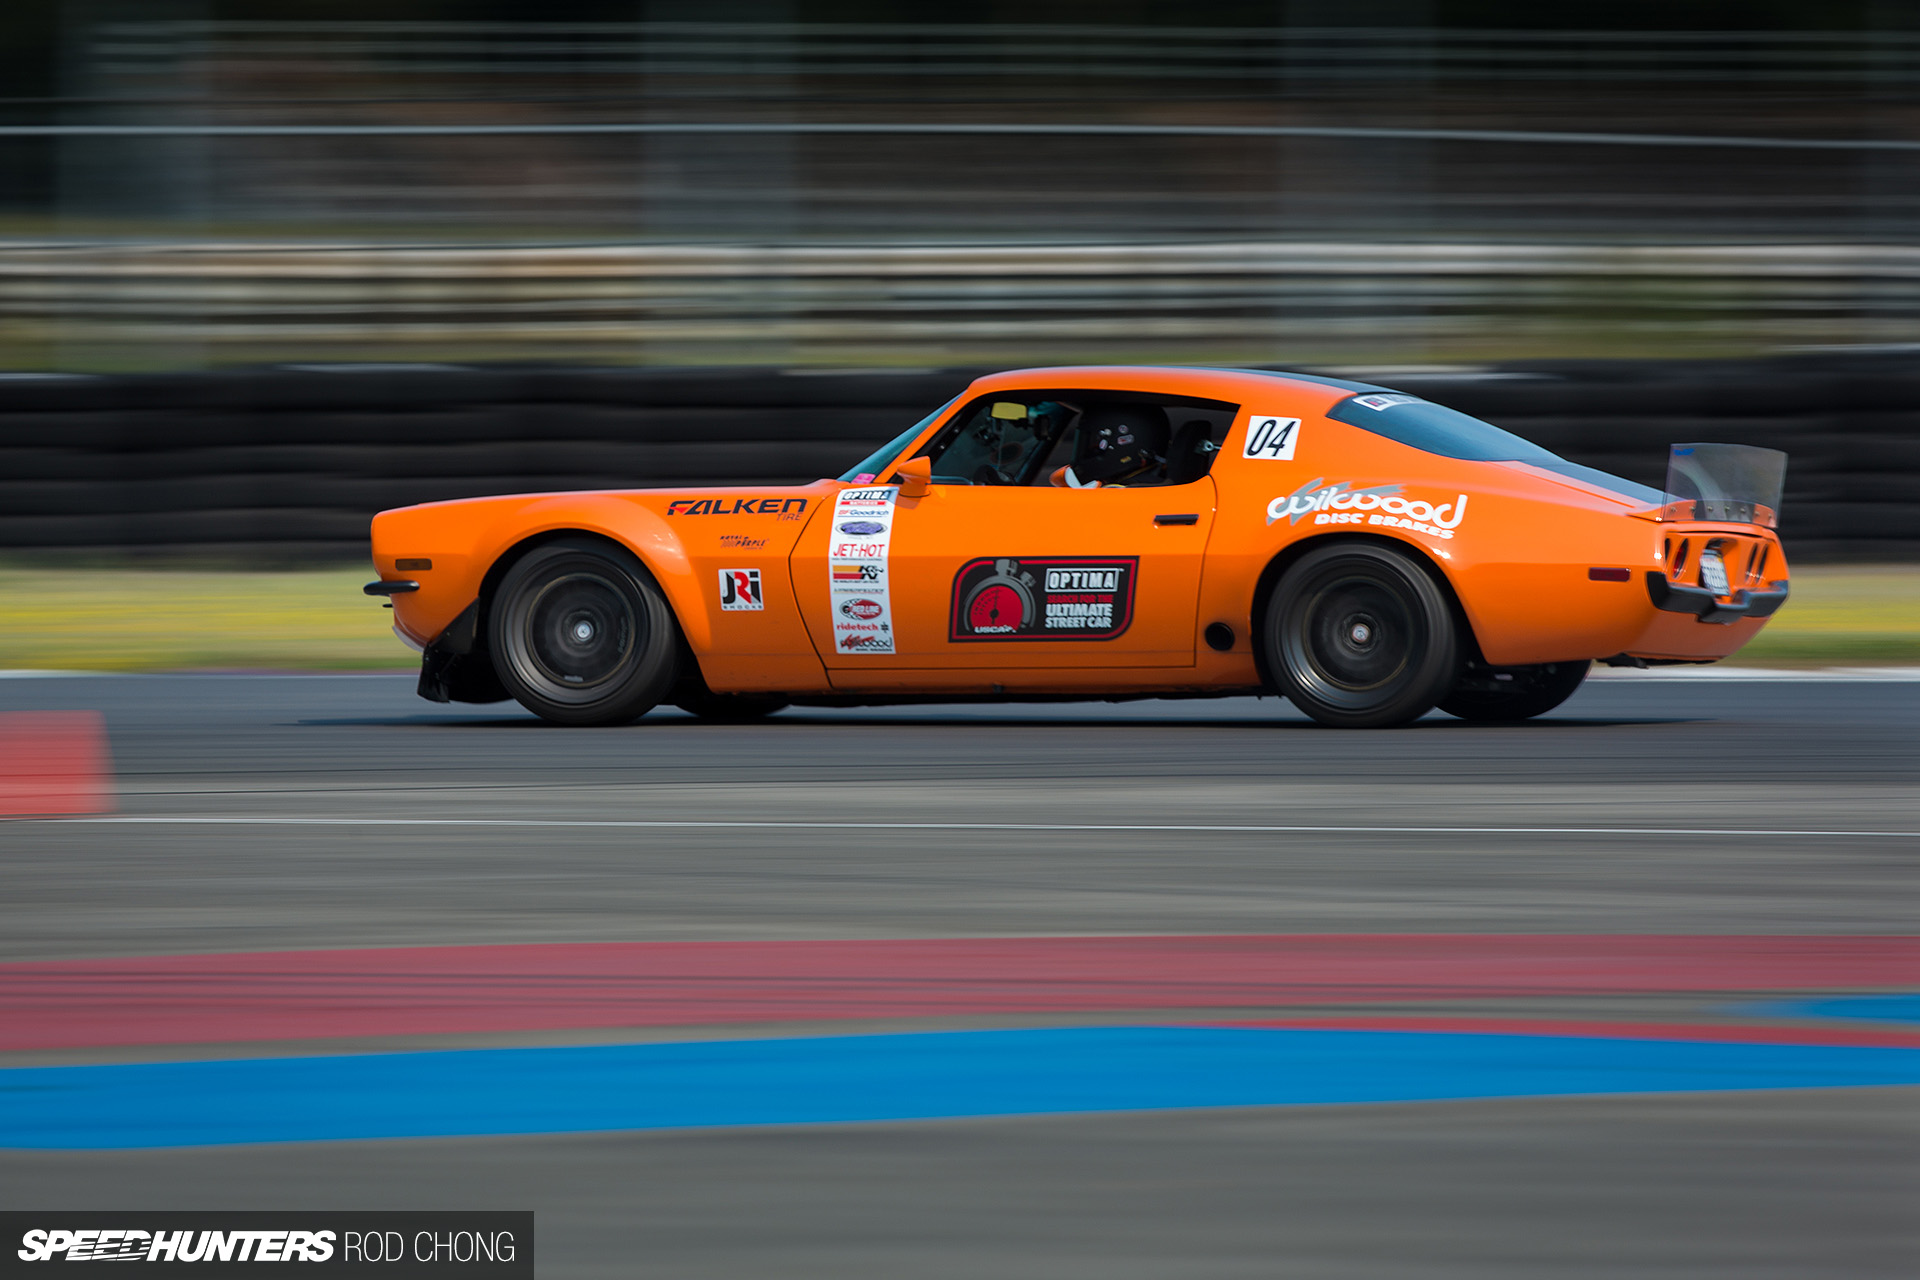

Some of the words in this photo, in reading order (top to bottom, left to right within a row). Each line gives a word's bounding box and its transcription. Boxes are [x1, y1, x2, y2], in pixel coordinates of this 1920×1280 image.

[1247, 419, 1296, 457] 04
[842, 490, 891, 500] OPTIMA
[667, 499, 808, 515] FALKEN
[1266, 487, 1468, 529] wilwood
[776, 513, 802, 521] TIRE
[1314, 513, 1365, 525] DISC
[1368, 514, 1455, 539] BRAKES
[833, 544, 885, 557] JET-HOT
[1049, 572, 1114, 588] OPTIMA
[1080, 595, 1097, 603] FOR
[1046, 603, 1113, 617] ULTIMATE
[837, 622, 879, 631] ridetech
[1044, 616, 1087, 628] STREET
[1087, 616, 1112, 628] CAR
